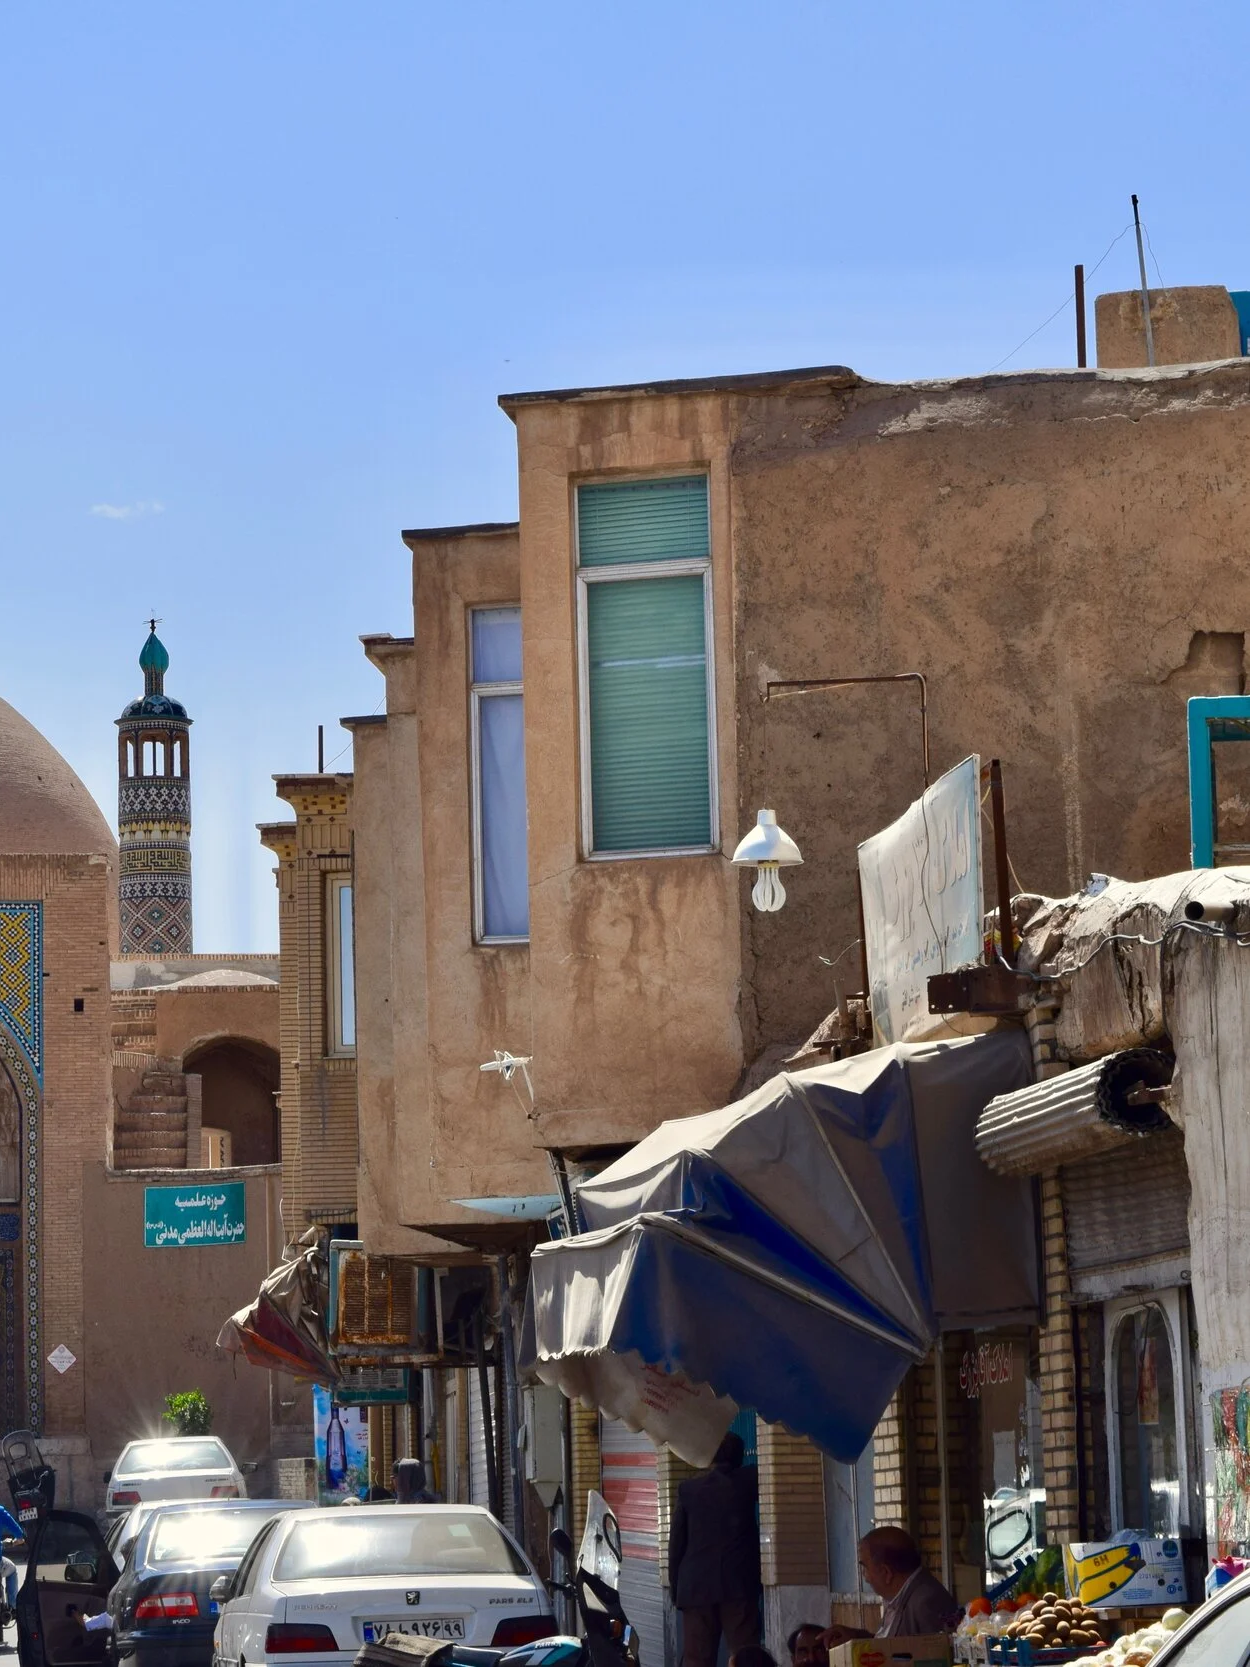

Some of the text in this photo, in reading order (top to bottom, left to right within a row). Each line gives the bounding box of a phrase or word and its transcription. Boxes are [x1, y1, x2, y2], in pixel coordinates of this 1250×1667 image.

[174, 1192, 226, 1212] حوزه علمیه
[177, 1219, 207, 1245] العظمی
